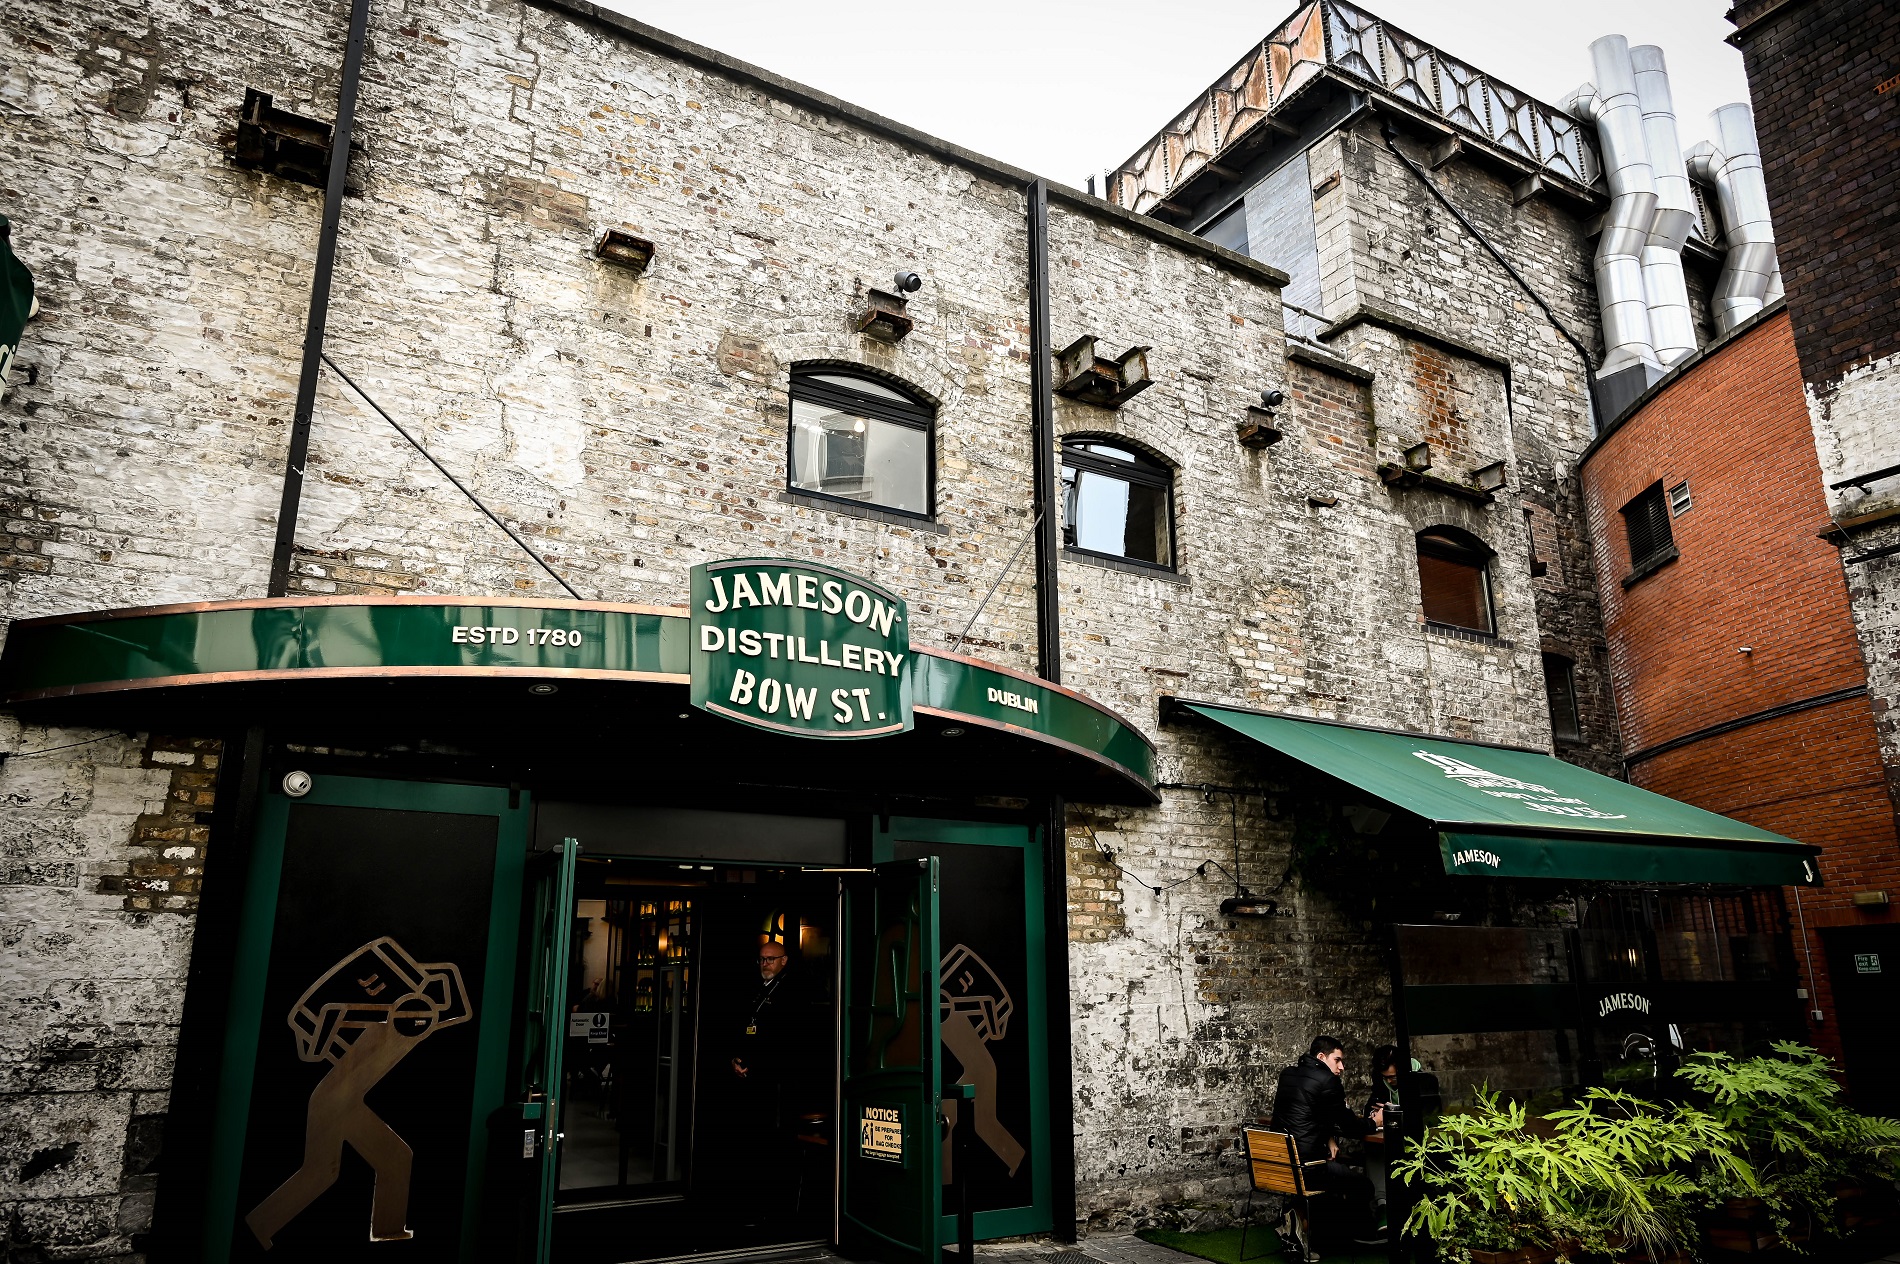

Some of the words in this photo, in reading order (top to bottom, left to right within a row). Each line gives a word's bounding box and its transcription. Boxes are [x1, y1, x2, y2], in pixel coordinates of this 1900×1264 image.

[705, 572, 897, 637] JAMESON
[452, 625, 519, 644] ESTD
[526, 628, 582, 647] 1780
[700, 624, 904, 677] DISTILLERY
[729, 668, 818, 720] BOW
[831, 687, 886, 723] ST.
[987, 687, 1038, 714] DUBLIN
[1599, 992, 1650, 1017] JAMESON
[865, 1107, 899, 1122] NOTICE
